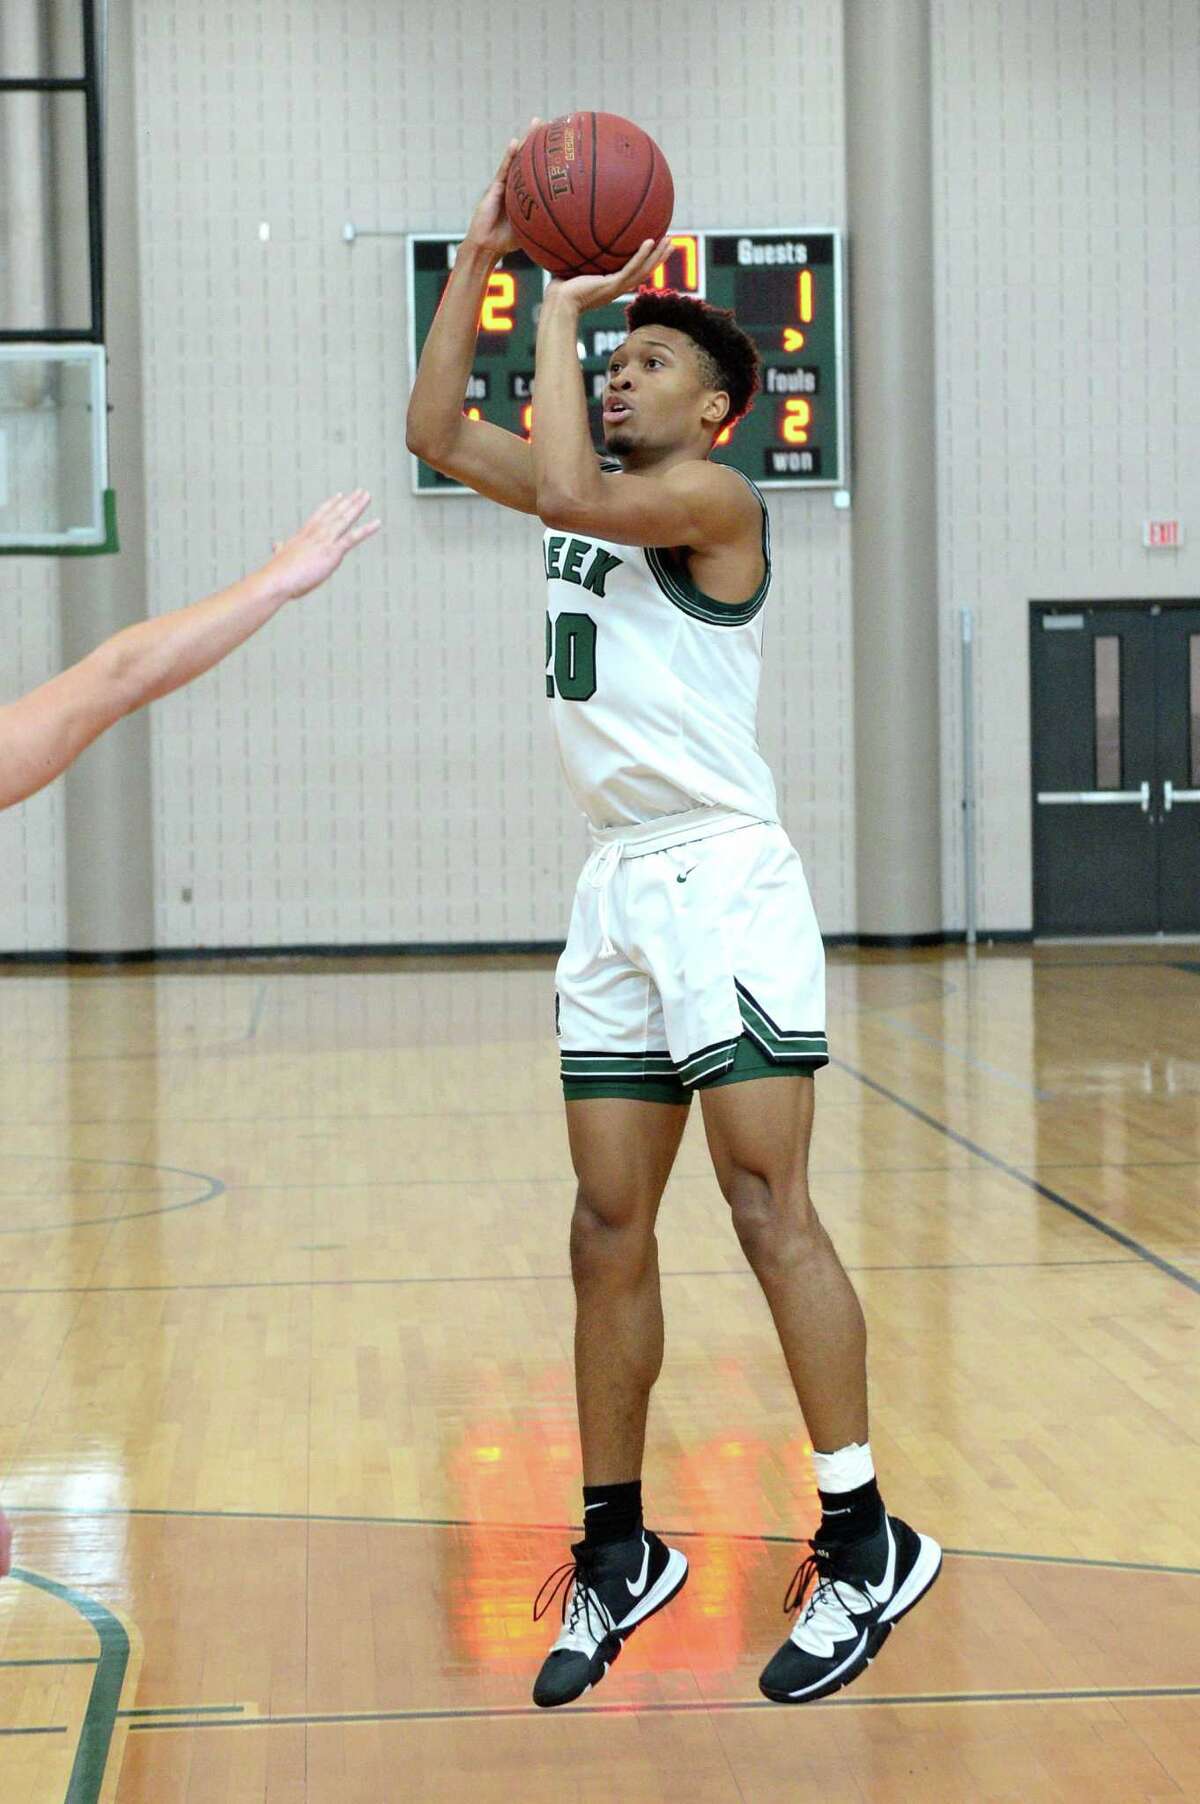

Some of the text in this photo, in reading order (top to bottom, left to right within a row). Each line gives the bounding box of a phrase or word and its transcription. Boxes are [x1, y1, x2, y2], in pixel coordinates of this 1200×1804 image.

[737, 238, 808, 265] Guests
[481, 272, 516, 331] 2
[799, 270, 812, 323] 1
[767, 367, 816, 393] fouls
[783, 399, 809, 443] 2
[772, 451, 813, 472] won
[543, 536, 624, 598] EEK
